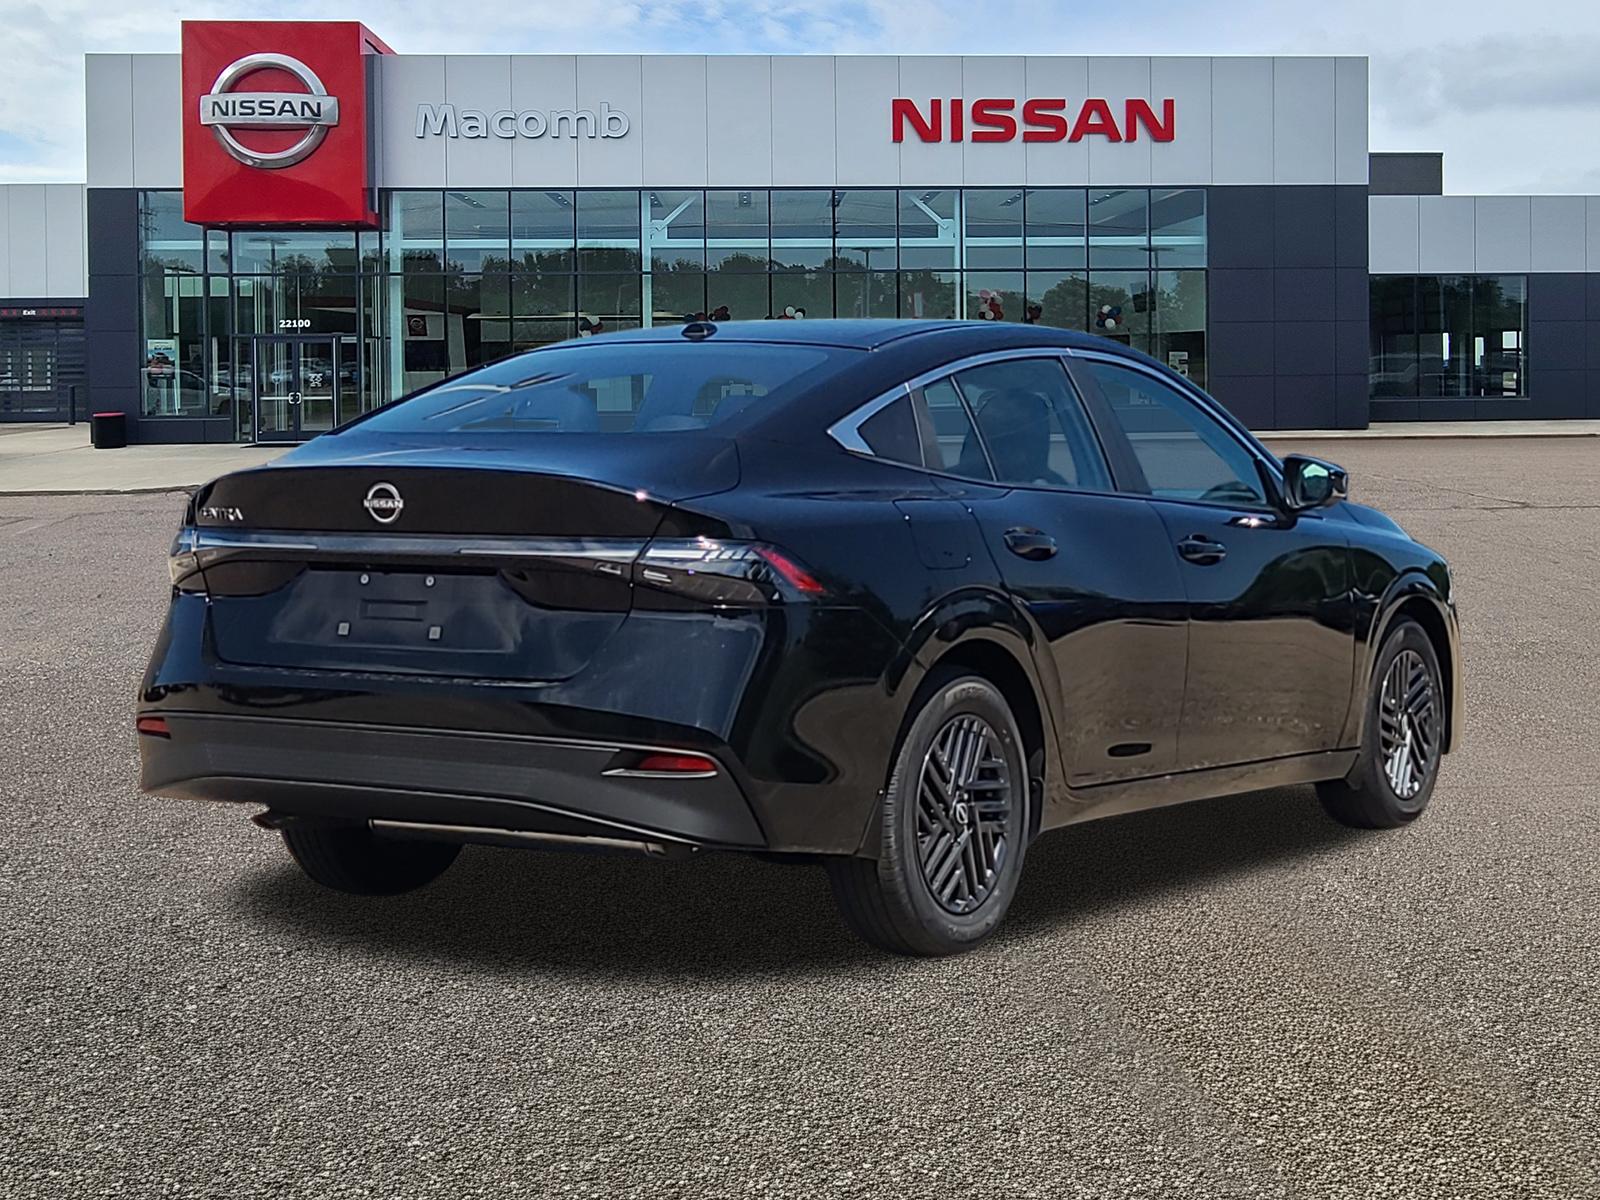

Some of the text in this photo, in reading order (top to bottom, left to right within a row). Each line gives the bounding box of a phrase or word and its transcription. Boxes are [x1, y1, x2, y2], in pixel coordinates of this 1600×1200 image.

[211, 100, 321, 118] NISSAN
[415, 102, 630, 138] Macomb
[892, 98, 1175, 142] NISSAN
[279, 319, 311, 328] 22100
[364, 498, 404, 509] NISSAN
[201, 507, 244, 520] NTRA
